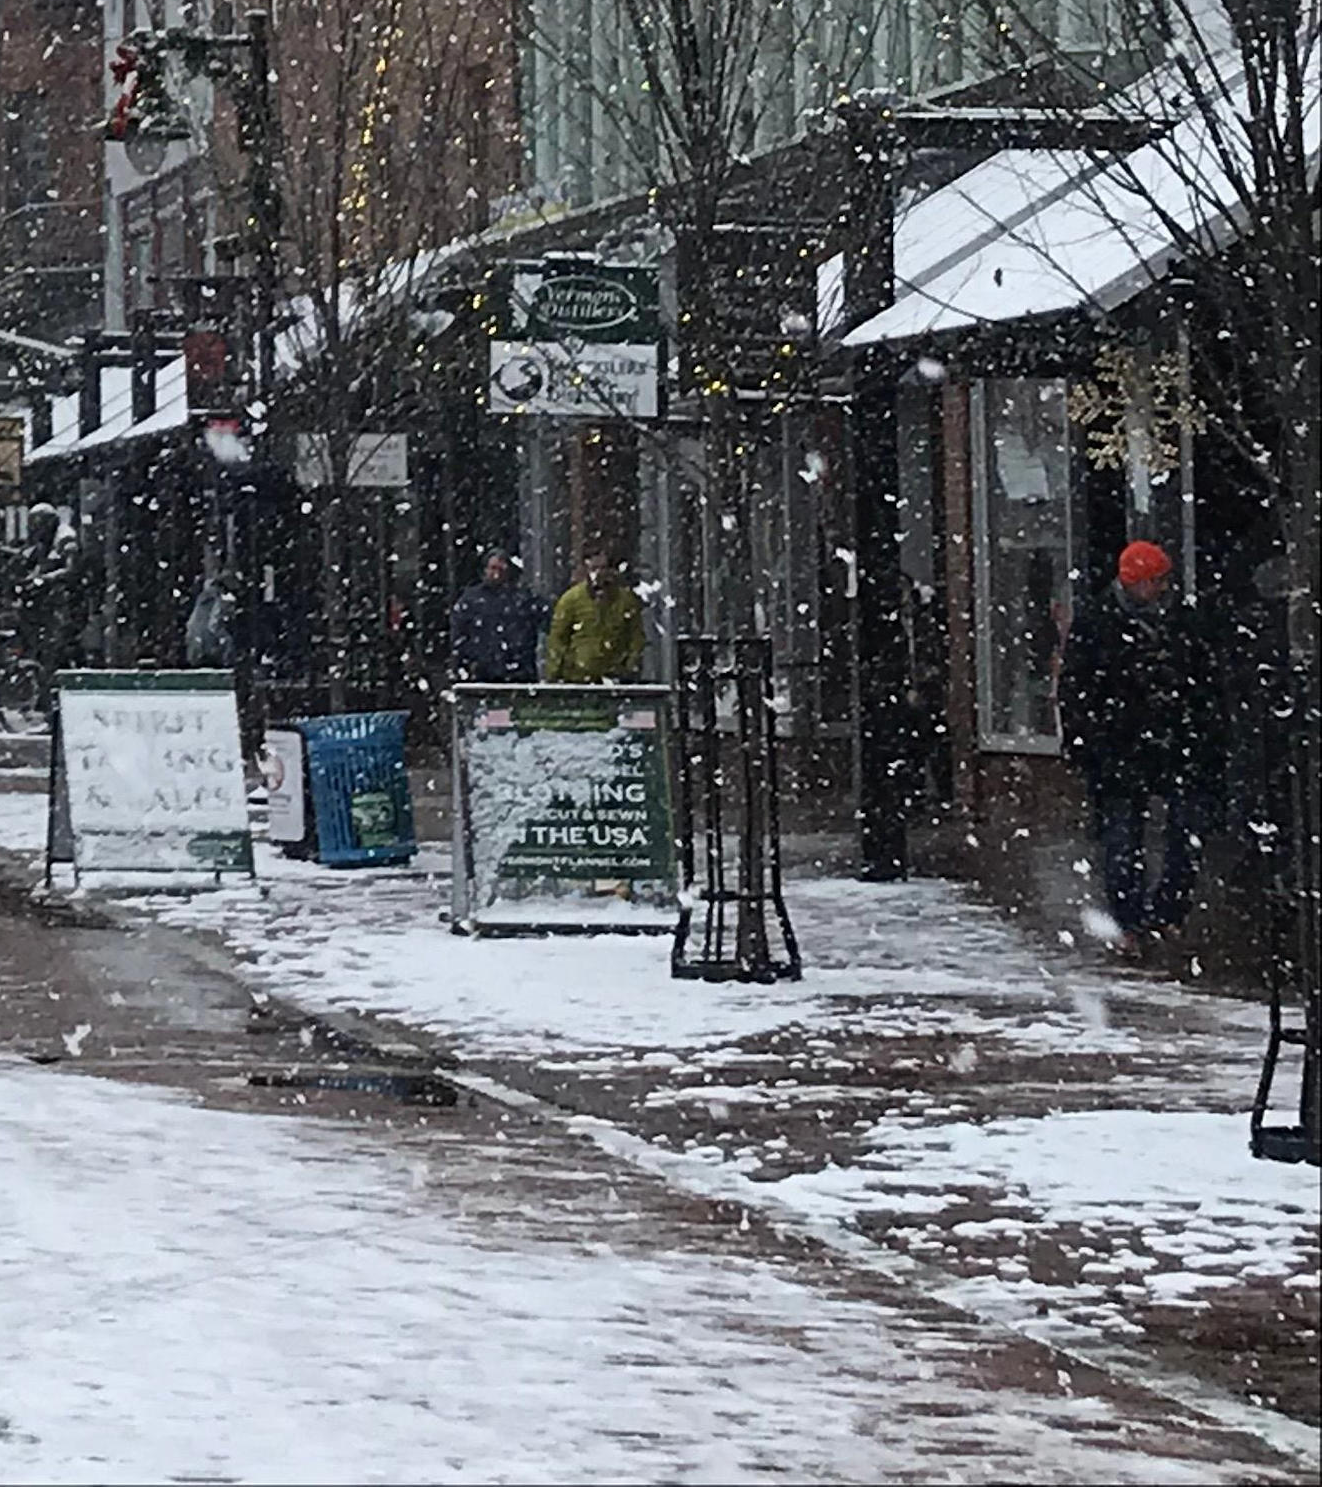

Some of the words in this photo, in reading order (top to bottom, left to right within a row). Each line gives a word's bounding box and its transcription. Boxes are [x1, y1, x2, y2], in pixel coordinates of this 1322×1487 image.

[596, 809, 648, 822] SEWN
[531, 826, 587, 845] THE
[592, 825, 649, 846] USA
